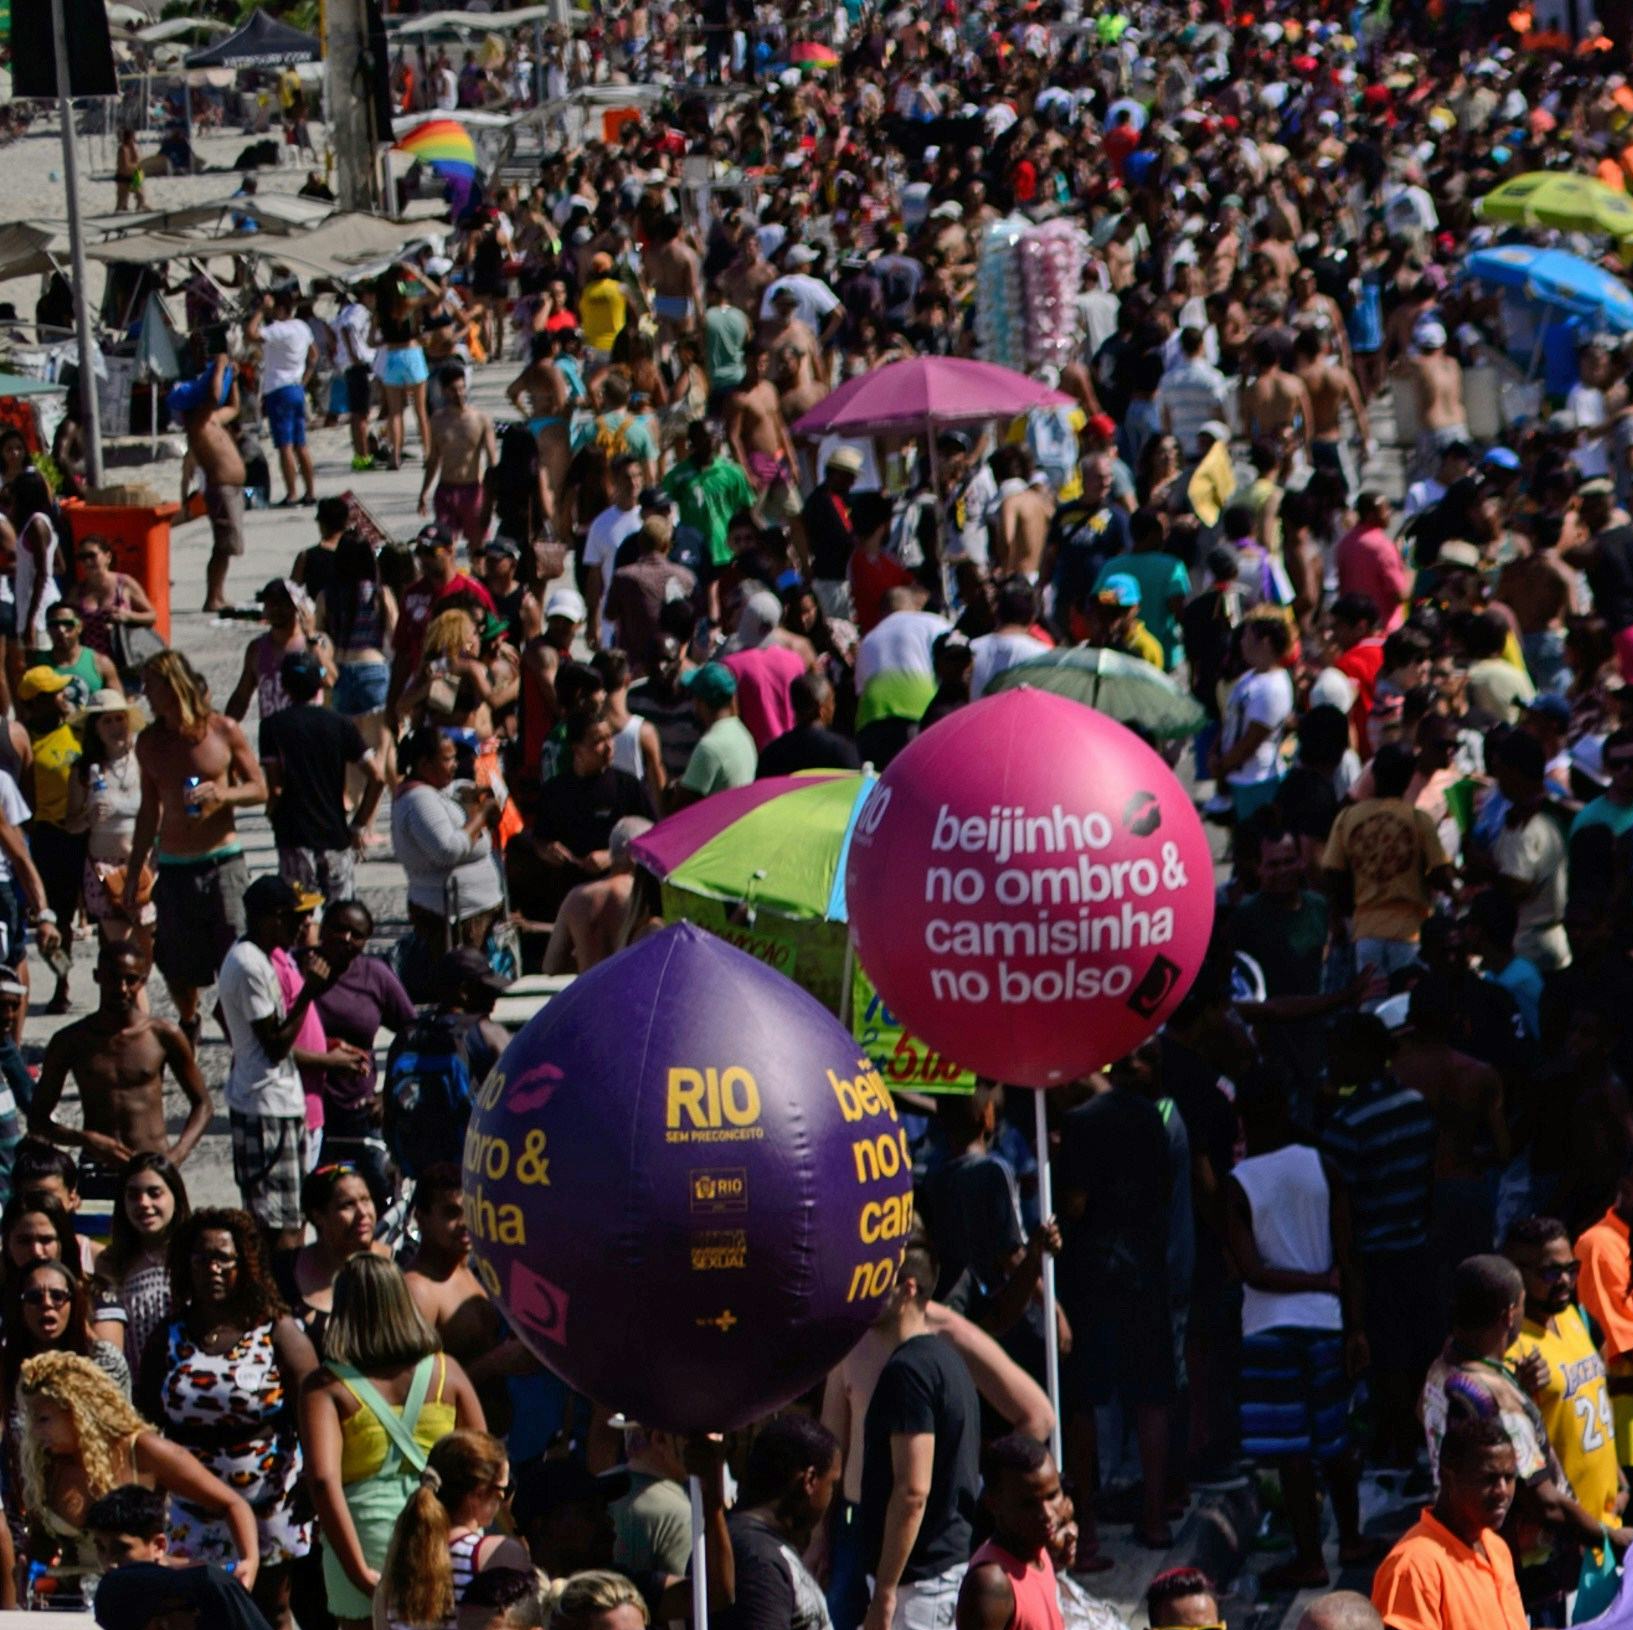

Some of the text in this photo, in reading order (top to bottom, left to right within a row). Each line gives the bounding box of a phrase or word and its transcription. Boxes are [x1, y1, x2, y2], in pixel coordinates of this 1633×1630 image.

[931, 804, 1113, 863] beijinho
[925, 840, 1188, 906] no ombro &
[925, 902, 1174, 957] camisinha
[930, 959, 1132, 1003] no bolso
[667, 1066, 761, 1128] RIO
[516, 1128, 550, 1186] &
[665, 1127, 764, 1143] SEM PRECONCEITO
[852, 1134, 899, 1183] no
[717, 1178, 743, 1194] RIO
[847, 1257, 893, 1303] no
[1575, 1386, 1615, 1453] 24
